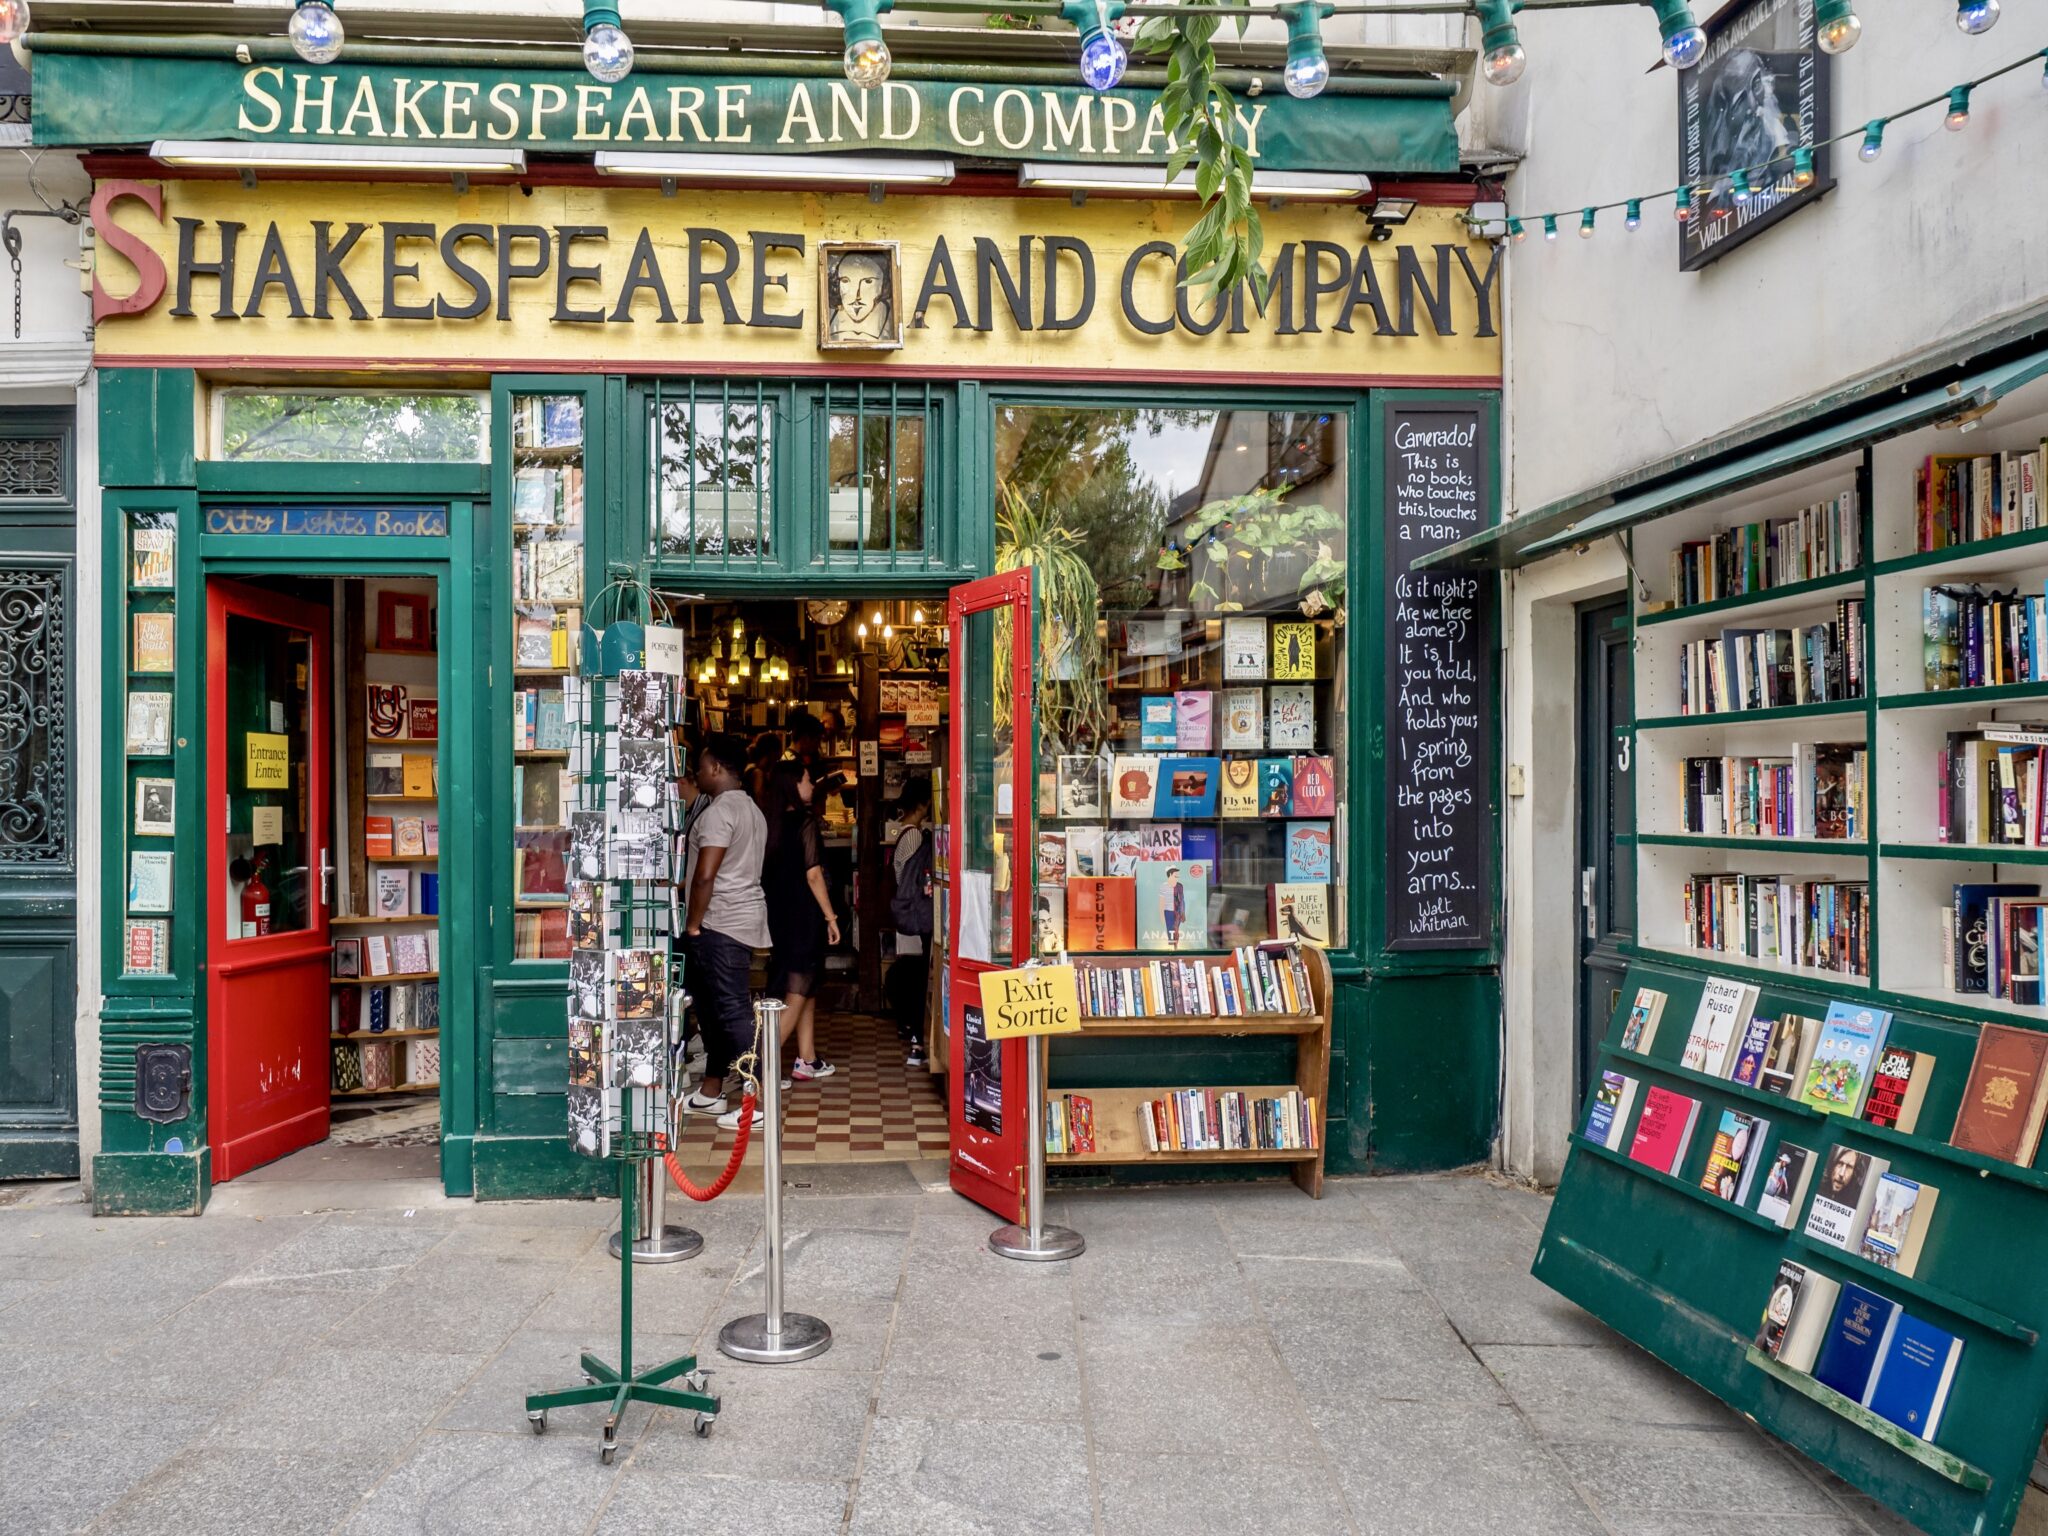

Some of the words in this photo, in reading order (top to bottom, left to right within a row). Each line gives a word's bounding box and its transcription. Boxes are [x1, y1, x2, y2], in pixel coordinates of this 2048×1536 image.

[238, 66, 752, 143] SHAKESPEARE
[776, 82, 921, 144] AND
[1700, 212, 1732, 250] WALT
[93, 180, 805, 328] SHAKESPEARE
[909, 234, 1096, 333] AND
[1395, 422, 1476, 449] Camerado!
[1401, 453, 1437, 470] This
[1446, 453, 1459, 468] is
[1408, 473, 1425, 483] no
[1431, 470, 1472, 486] book;
[1427, 485, 1476, 501] touches
[207, 509, 275, 534] City
[281, 508, 366, 534] Lights
[1398, 502, 1427, 517] this,
[1429, 503, 1476, 520] touches
[1400, 524, 1411, 540] a
[1421, 525, 1460, 540] man;
[1395, 574, 1412, 599] (Is
[1417, 576, 1428, 598] it
[1434, 578, 1477, 605] night?
[1396, 602, 1419, 621] Are
[1424, 608, 1440, 620] we
[1442, 605, 1472, 620] here
[1405, 620, 1466, 642] alone?)
[1400, 643, 1412, 664] It
[1424, 644, 1439, 661] is
[1449, 640, 1454, 663] I
[1401, 669, 1431, 687] you
[1436, 660, 1476, 682] hold,
[1399, 687, 1434, 707] And
[1442, 685, 1471, 705] who
[1406, 708, 1446, 730] holds
[1450, 715, 1477, 738] you;
[250, 743, 286, 761] Entrance
[1401, 736, 1406, 760] I
[1418, 738, 1471, 767] spring
[1618, 736, 1630, 772] 3
[255, 763, 282, 779] Entrée
[1307, 773, 1319, 785] RED
[1411, 759, 1454, 787] from
[1302, 785, 1325, 798] CLOCKS
[1398, 785, 1424, 807] the
[1429, 788, 1471, 815] pages
[1414, 815, 1452, 840] into
[1142, 829, 1181, 847] MARS
[1407, 846, 1453, 874] your
[1408, 871, 1476, 894] arms...
[1300, 895, 1318, 903] LIFE
[1419, 897, 1452, 917] Walt
[1307, 916, 1321, 925] ME
[1410, 914, 1469, 933] Whitman
[1142, 930, 1206, 941] ANATOMY
[1003, 977, 1053, 1003] Exit
[1706, 982, 1738, 998] Richard
[997, 1001, 1067, 1029] Sortie
[1707, 998, 1733, 1014] Russo
[1687, 1035, 1726, 1052] STRAIGHT
[1887, 1054, 1909, 1068] JOHN
[1823, 1200, 1852, 1218] STRUGGLE
[1811, 1213, 1823, 1225] KARL
[1824, 1219, 1836, 1230] OVE
[1808, 1222, 1846, 1244] KNAUSGAARD
[1853, 1307, 1871, 1320] LIVRE
[1844, 1317, 1872, 1337] MORMON
